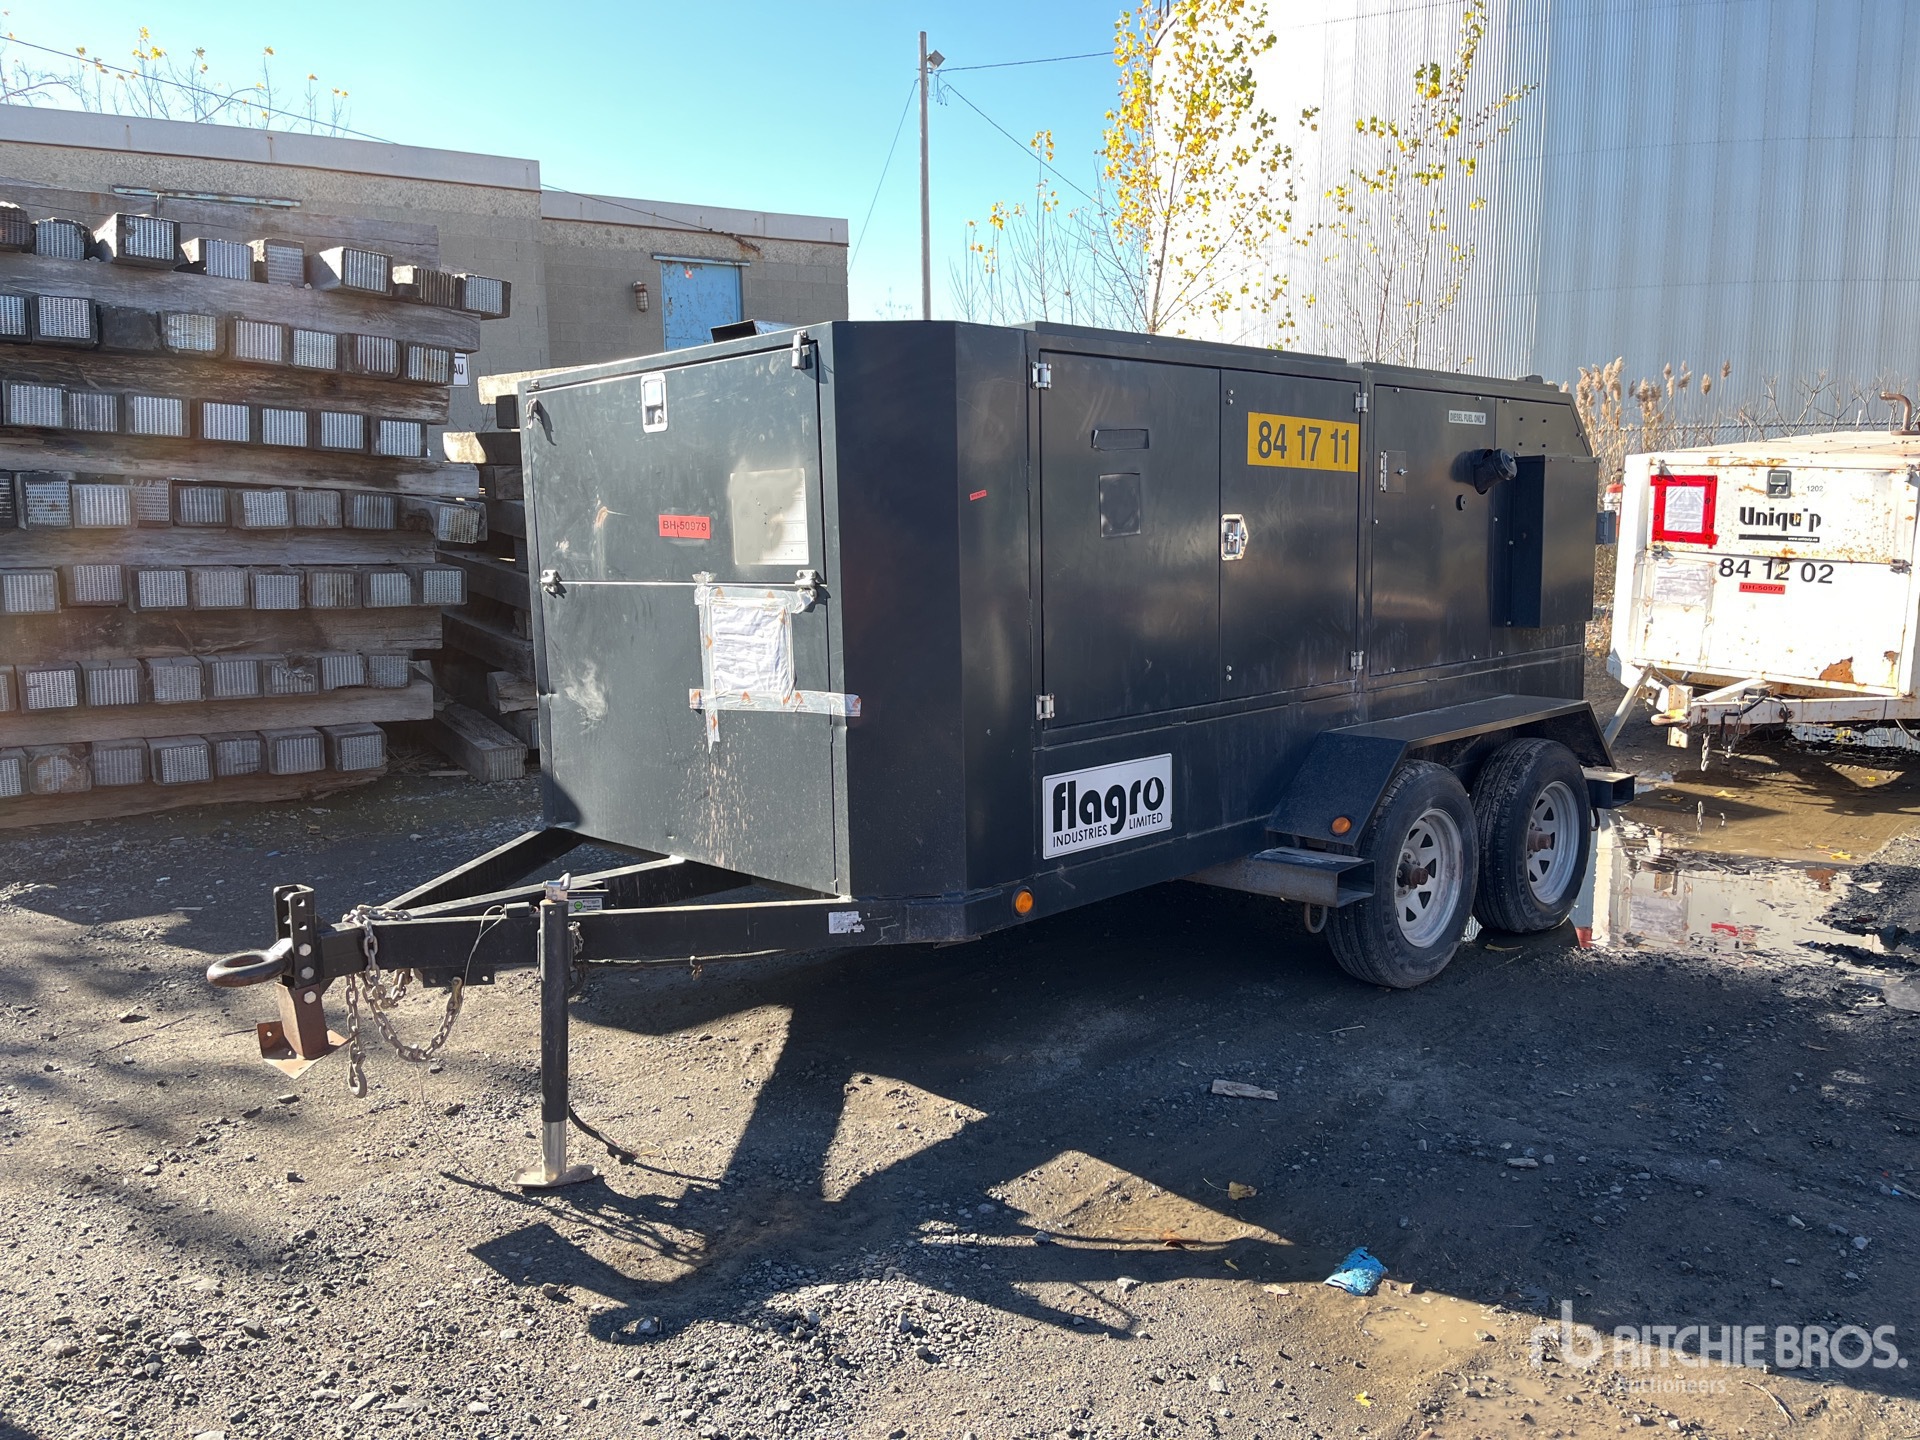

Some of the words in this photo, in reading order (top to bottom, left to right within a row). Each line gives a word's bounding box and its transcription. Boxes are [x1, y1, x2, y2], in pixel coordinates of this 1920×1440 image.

[1450, 412, 1463, 422] DIESEL
[1464, 414, 1474, 423] FUEL
[1474, 415, 1485, 424] ONLY
[1257, 420, 1288, 459] 84
[1297, 424, 1322, 462] 17
[1330, 428, 1350, 464] 11
[662, 520, 707, 531] BH-50979
[1739, 506, 1822, 533] Uniqup
[1718, 557, 1752, 579] 84
[1762, 558, 1791, 581] 12
[1800, 562, 1835, 584] 02
[1052, 776, 1165, 836] flagro
[1129, 812, 1163, 830] LIMITED
[1053, 824, 1108, 848] INDUSTRIES
